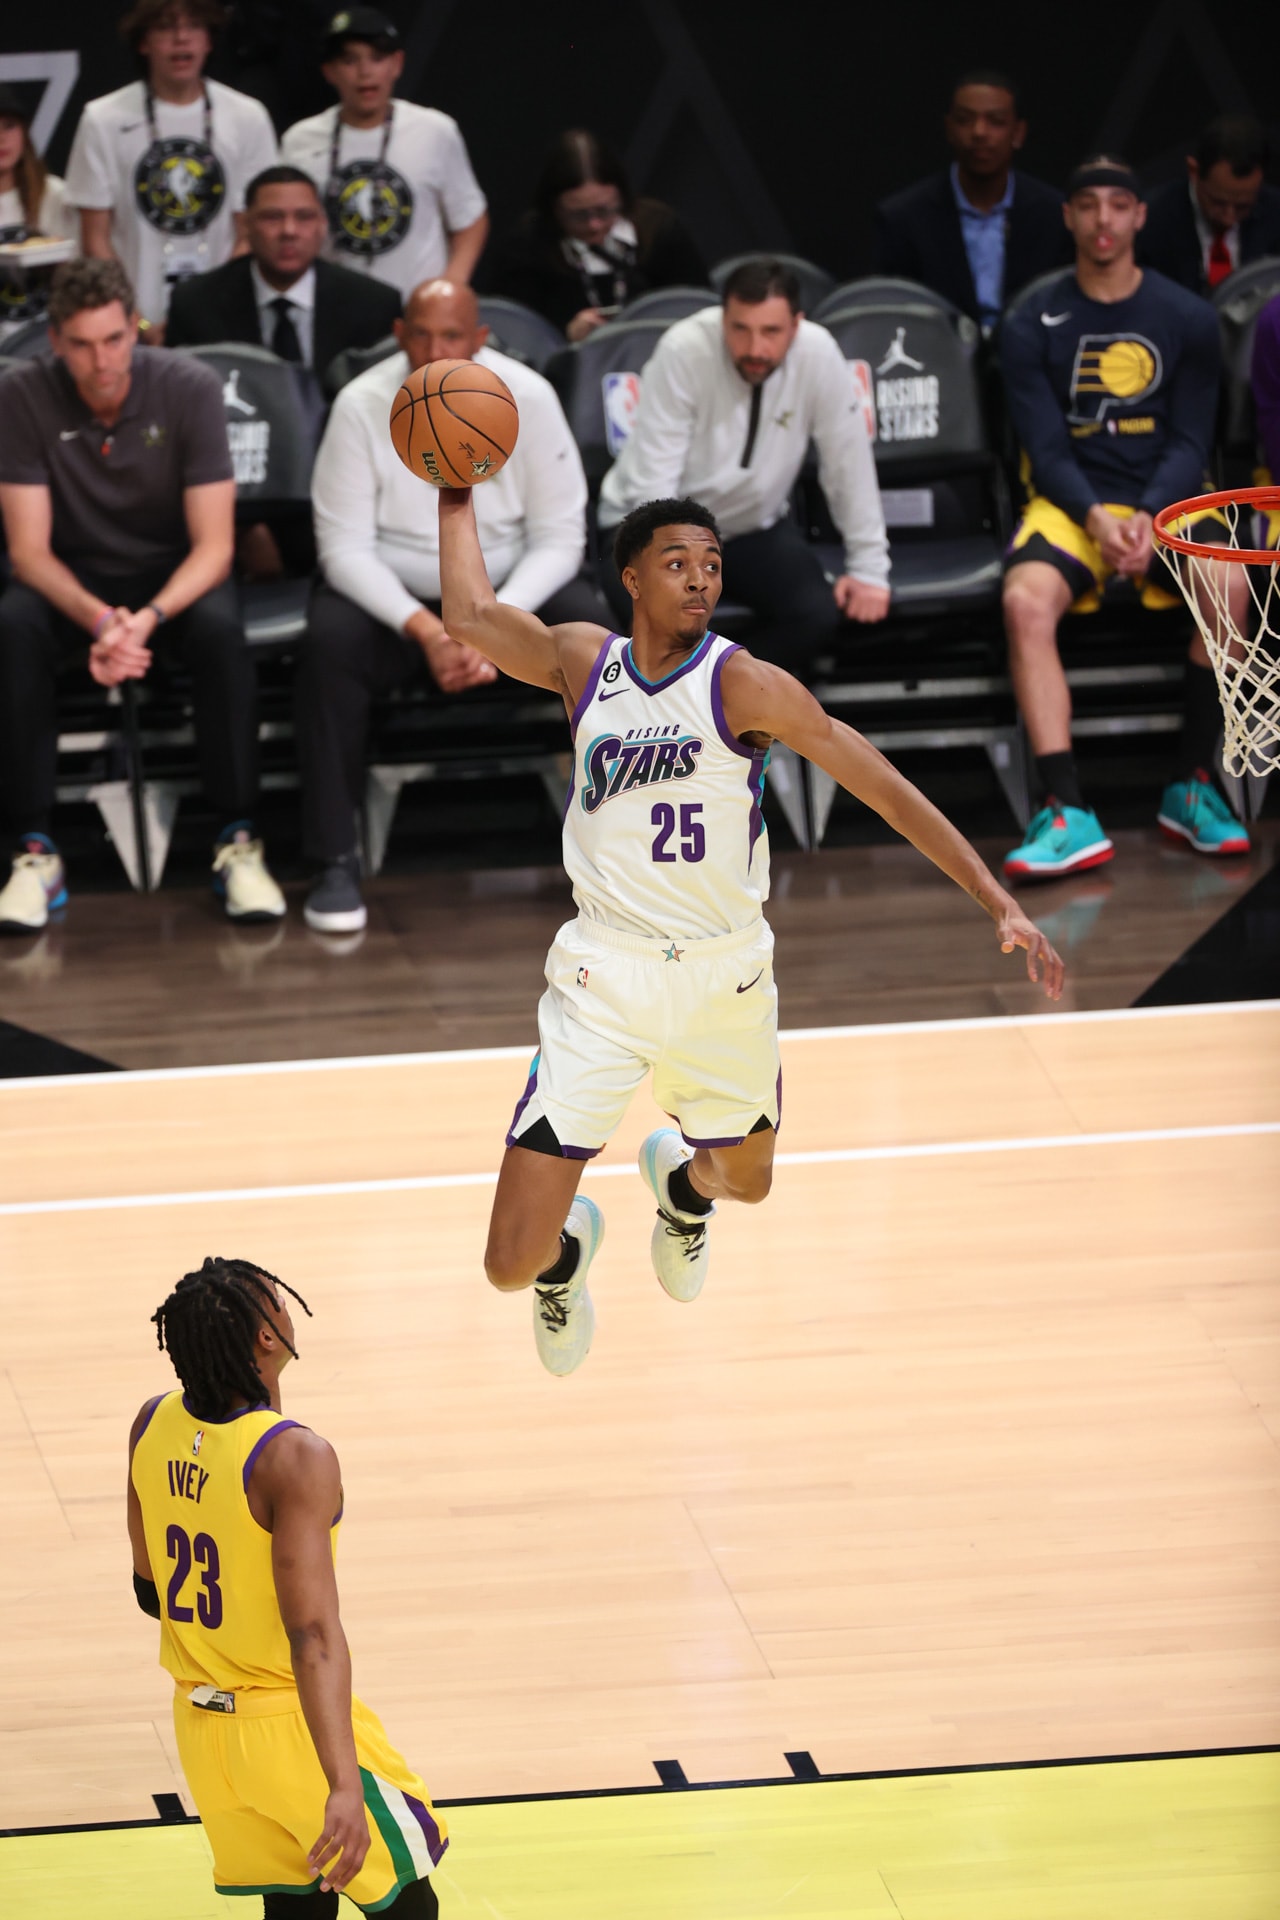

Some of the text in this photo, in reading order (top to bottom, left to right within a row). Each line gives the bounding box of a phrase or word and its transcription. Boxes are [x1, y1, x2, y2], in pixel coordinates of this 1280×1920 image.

[877, 375, 939, 408] RISING
[878, 407, 939, 442] STARS
[625, 724, 681, 741] RISING
[582, 734, 705, 815] STARS
[650, 802, 706, 863] 25
[167, 1460, 209, 1504] IVEY
[165, 1523, 223, 1630] 23
